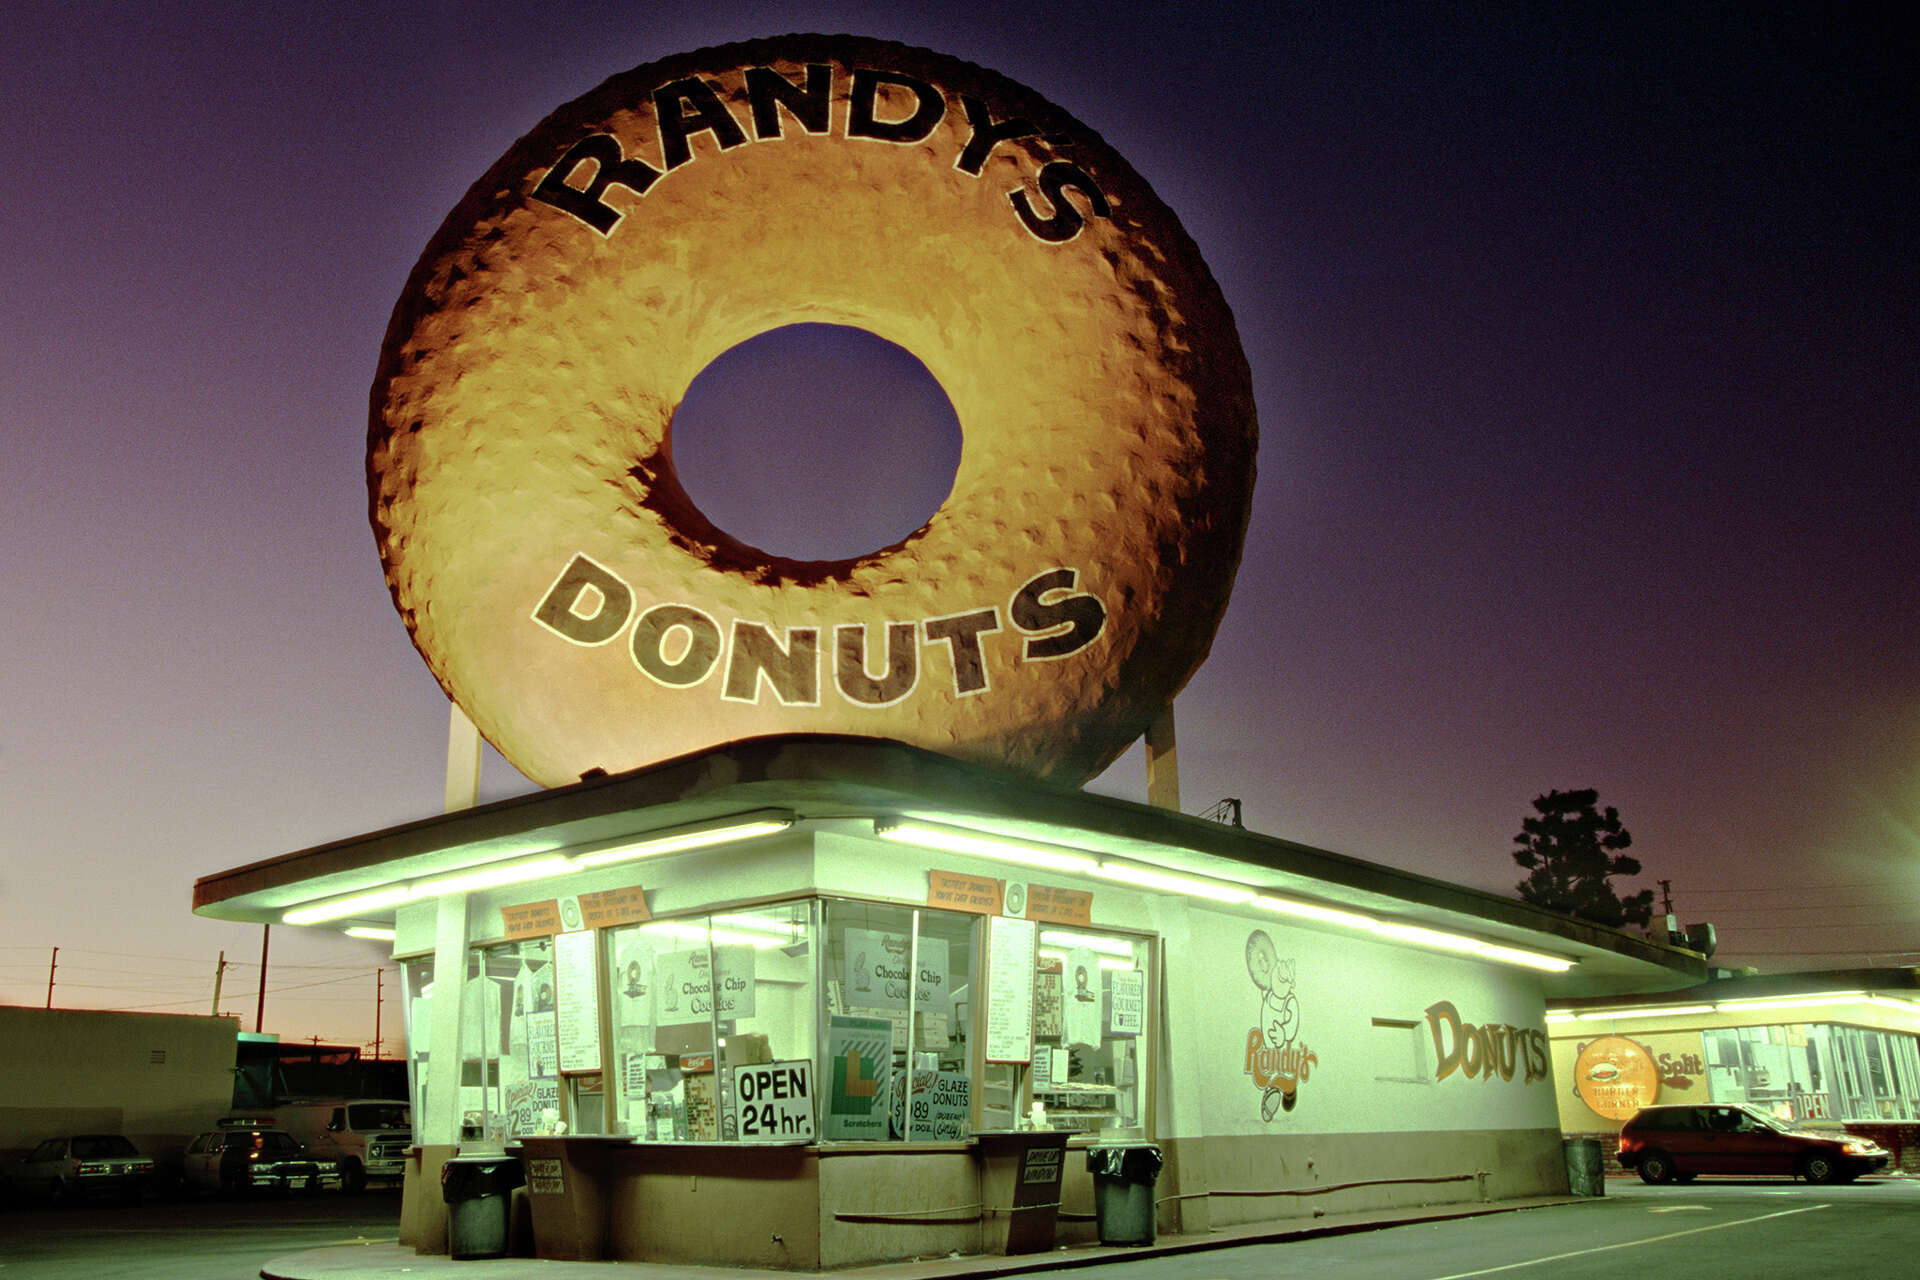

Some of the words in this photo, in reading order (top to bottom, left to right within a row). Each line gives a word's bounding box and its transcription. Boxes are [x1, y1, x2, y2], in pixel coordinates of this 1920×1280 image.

[530, 551, 1108, 708] DONUTS
[682, 979, 722, 995] Chocole
[725, 977, 746, 992] Chip
[875, 964, 912, 981] Chocola
[920, 970, 942, 986] Chip
[1424, 1000, 1547, 1085] DONUTS
[1658, 1053, 1704, 1078] Split
[740, 1068, 807, 1102] OPEN
[938, 1079, 968, 1093] GLAZE
[532, 1099, 560, 1112] DONUT
[933, 1093, 968, 1107] DONUTS
[742, 1104, 777, 1136] 24
[781, 1107, 811, 1135] hr.
[843, 1119, 882, 1128] Scratchers
